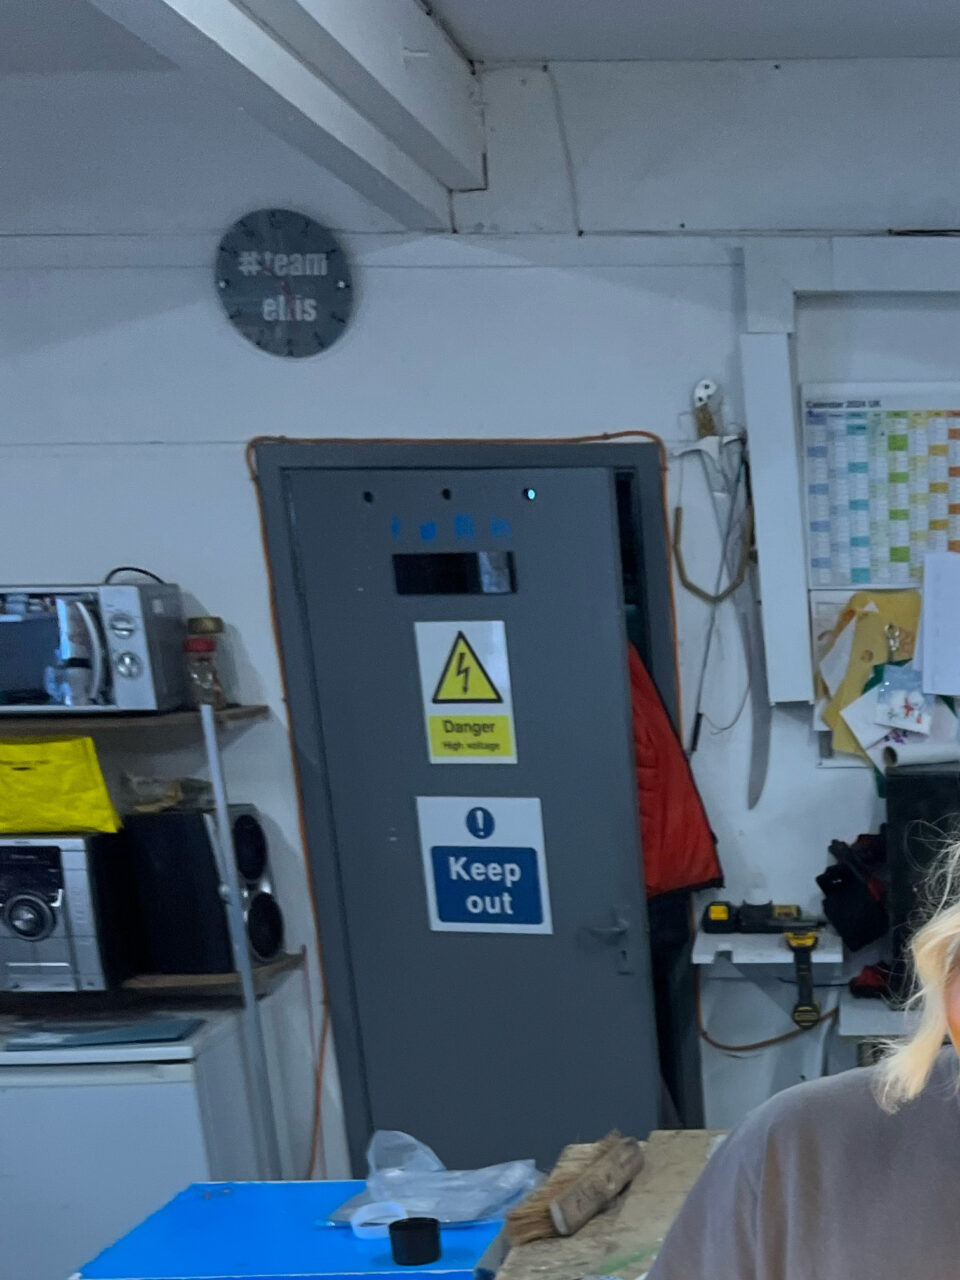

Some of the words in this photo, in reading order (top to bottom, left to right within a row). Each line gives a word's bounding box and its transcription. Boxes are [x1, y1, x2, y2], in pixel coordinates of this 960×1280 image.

[239, 251, 328, 276] #team
[443, 719, 496, 737] Danger
[448, 856, 521, 887] Keep
[465, 892, 514, 914] out
